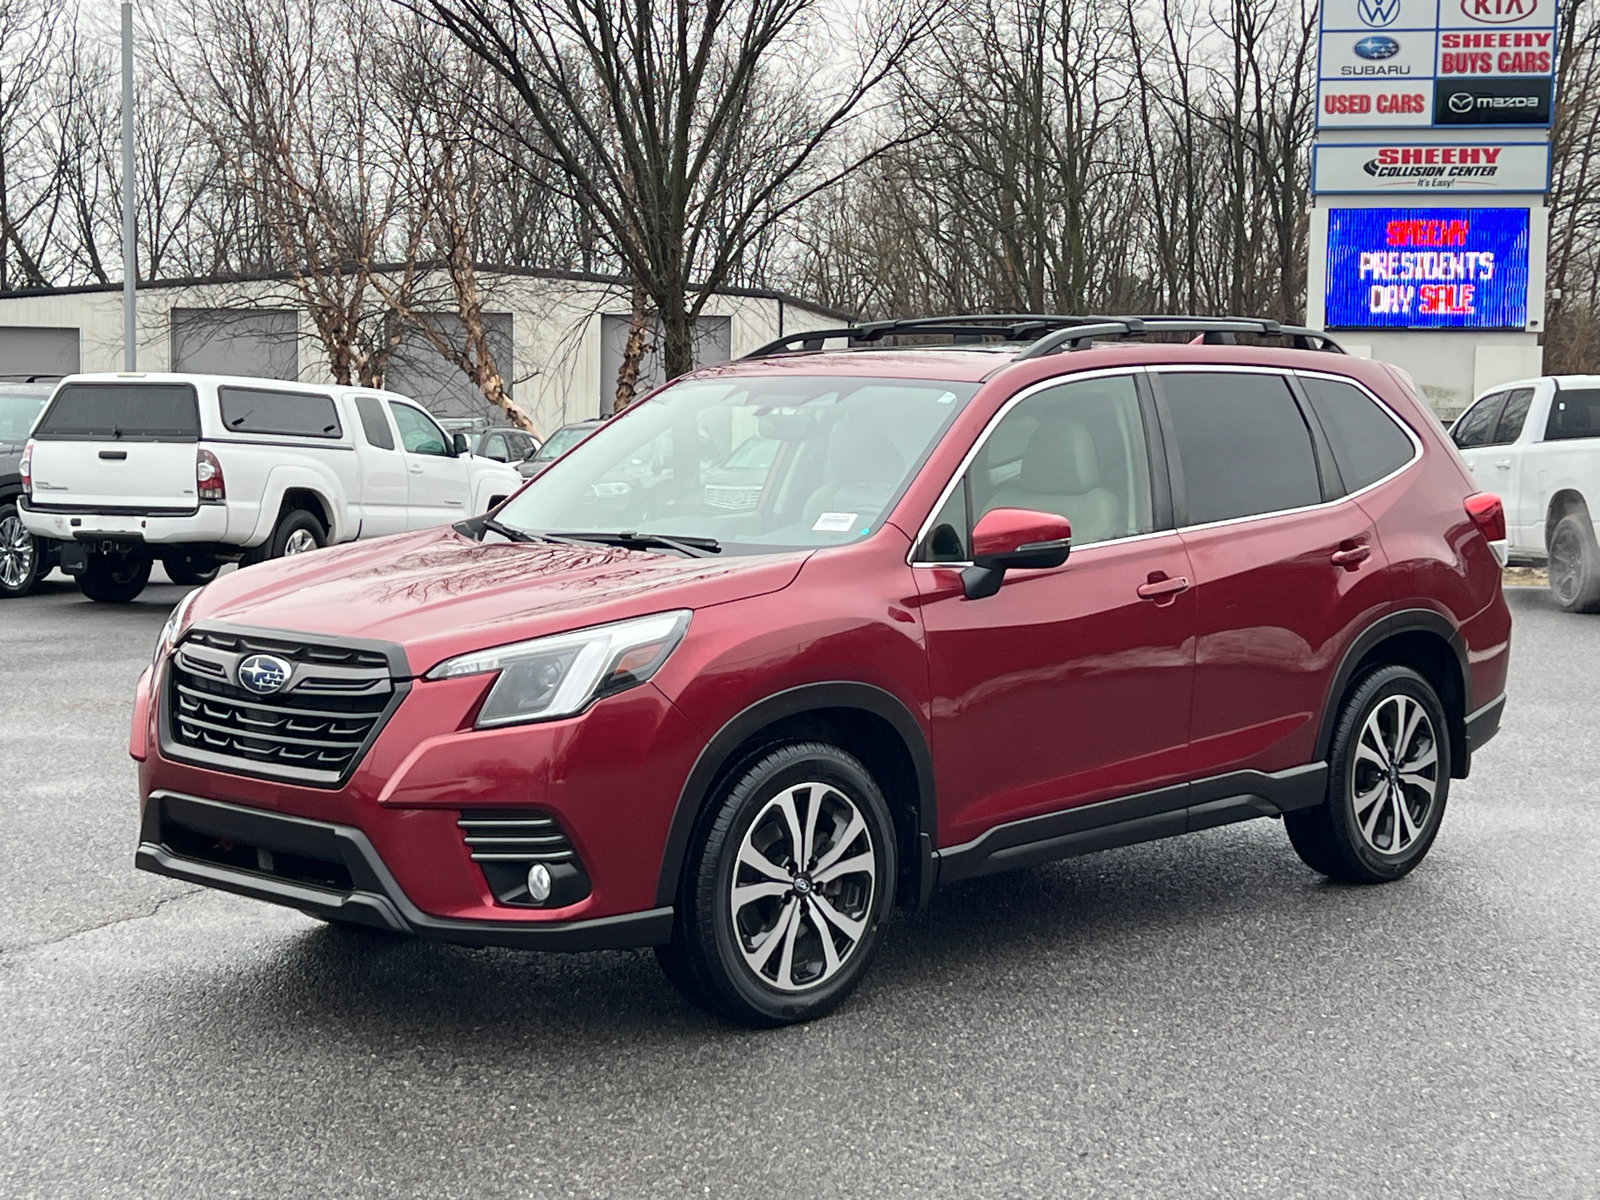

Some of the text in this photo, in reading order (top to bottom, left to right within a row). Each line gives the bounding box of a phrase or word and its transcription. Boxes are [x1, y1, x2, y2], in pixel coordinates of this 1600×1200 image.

[1474, 0, 1524, 15] KIA
[1441, 33, 1552, 48] SHEEHY
[1441, 51, 1551, 74] BUYS CARS
[1341, 66, 1411, 75] SUBARU
[1324, 94, 1425, 114] USED CARS
[1377, 148, 1502, 164] SHEEHY
[1377, 166, 1498, 177] COLLISION CENTER
[1417, 178, 1455, 188] It's Easy!
[1370, 284, 1476, 314] DAY SALE
